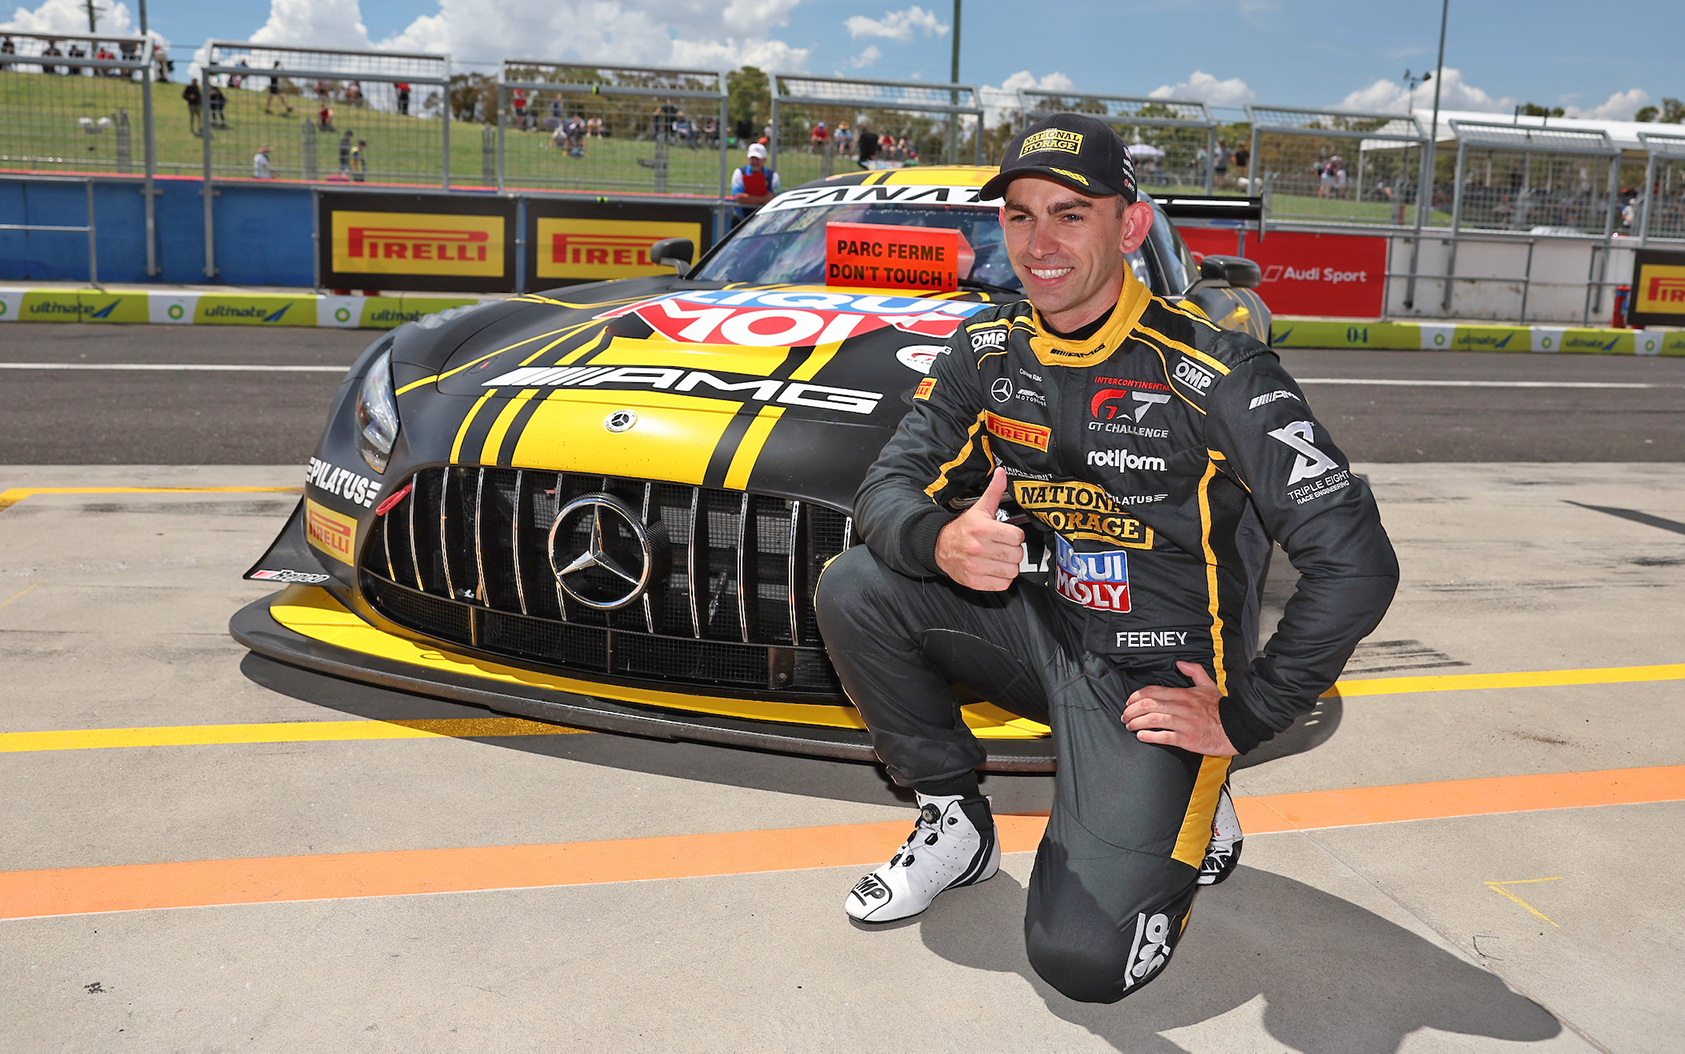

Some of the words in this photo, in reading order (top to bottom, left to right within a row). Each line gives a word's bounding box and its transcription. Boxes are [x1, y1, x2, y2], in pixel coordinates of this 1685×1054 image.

[1023, 139, 1076, 154] STORAGE
[1025, 130, 1081, 145] NATIONAL
[348, 227, 489, 262] PIRELLI
[552, 233, 673, 266] PIREL
[837, 240, 883, 258] PARC
[888, 243, 945, 262] FERME
[829, 263, 880, 281] DON'T
[883, 267, 942, 287] TOUCH
[1283, 266, 1321, 280] Audi
[1322, 268, 1367, 284] Sport
[29, 301, 96, 316] ultimate
[204, 304, 267, 318] ultimate
[666, 290, 980, 317] LIQUI
[971, 332, 1006, 349] OMP
[1347, 327, 1368, 344] 04
[1457, 333, 1498, 347] ultimate
[1565, 337, 1604, 348] ultimate
[1094, 376, 1171, 392] INTERCONTINENTAL
[1175, 362, 1212, 393] OMP
[588, 367, 883, 415] AMG
[987, 415, 1049, 448] PIRELLI
[1088, 421, 1104, 432] GT
[1105, 423, 1170, 439] CHALLENGE
[1087, 449, 1166, 473] rotiform
[310, 458, 369, 506] PILATUS
[1287, 480, 1325, 500] TRIPLE
[1325, 469, 1350, 487] EIGHT
[1297, 492, 1315, 505] RACE
[1315, 480, 1350, 500] ENGINEERING
[1021, 486, 1124, 515] NATION
[1113, 494, 1154, 507] ILATUS
[309, 509, 352, 554] PIRELLI
[1057, 537, 1124, 581] LIQUI
[1056, 571, 1127, 609] MOLY
[1116, 631, 1188, 648] FEENEY
